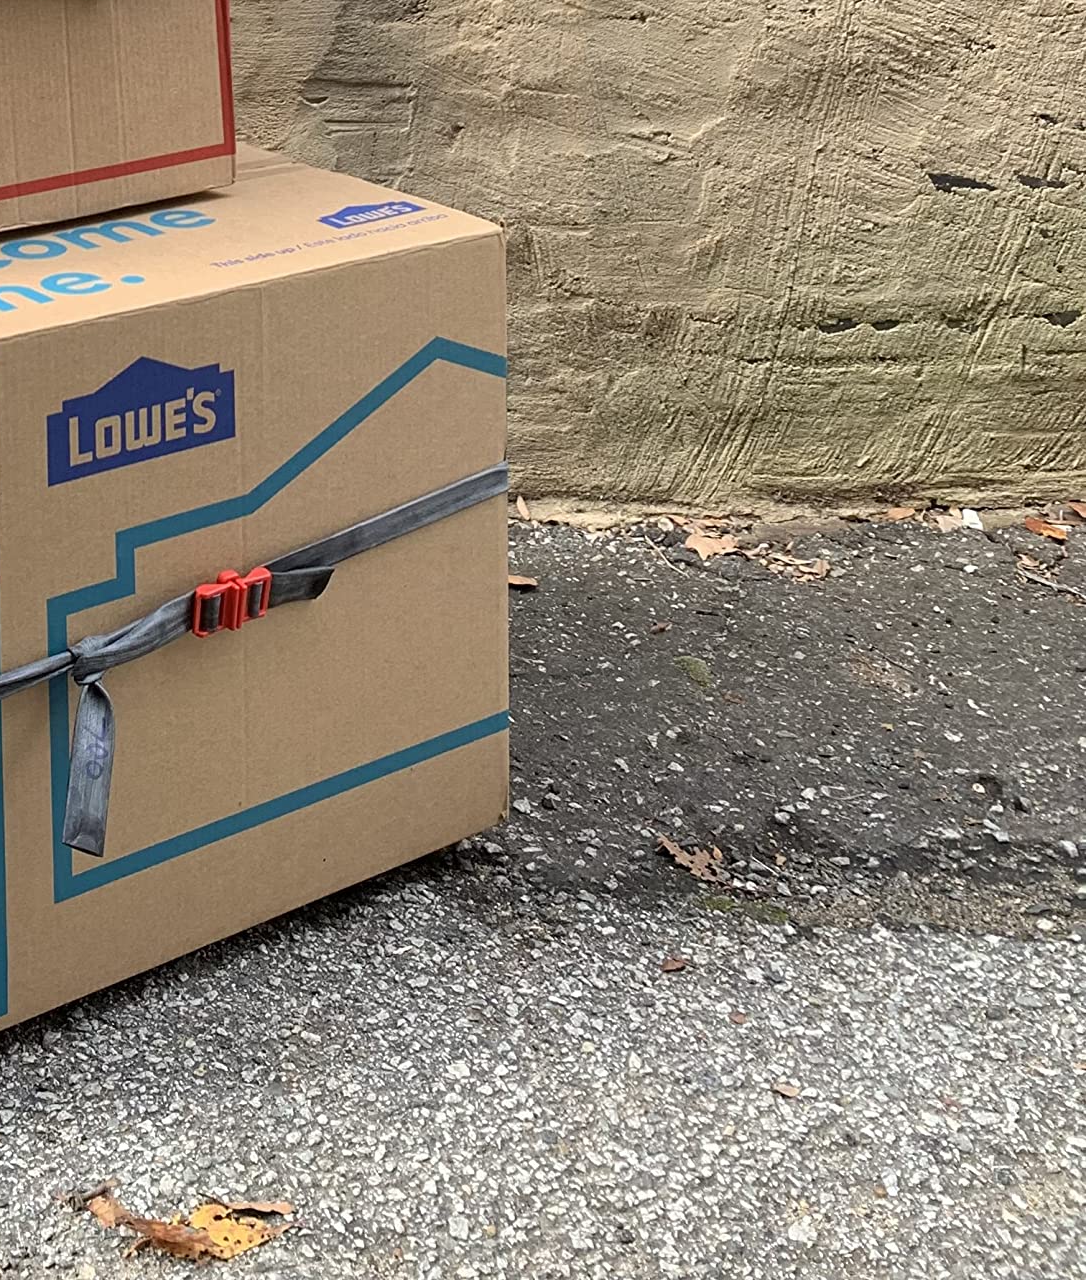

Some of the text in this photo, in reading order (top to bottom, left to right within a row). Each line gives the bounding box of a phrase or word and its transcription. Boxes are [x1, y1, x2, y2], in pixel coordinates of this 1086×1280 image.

[329, 204, 413, 226] LOWE'S
[210, 258, 243, 269] This
[246, 250, 275, 263] side
[276, 246, 296, 257] up
[68, 387, 217, 468] LOWE'S
